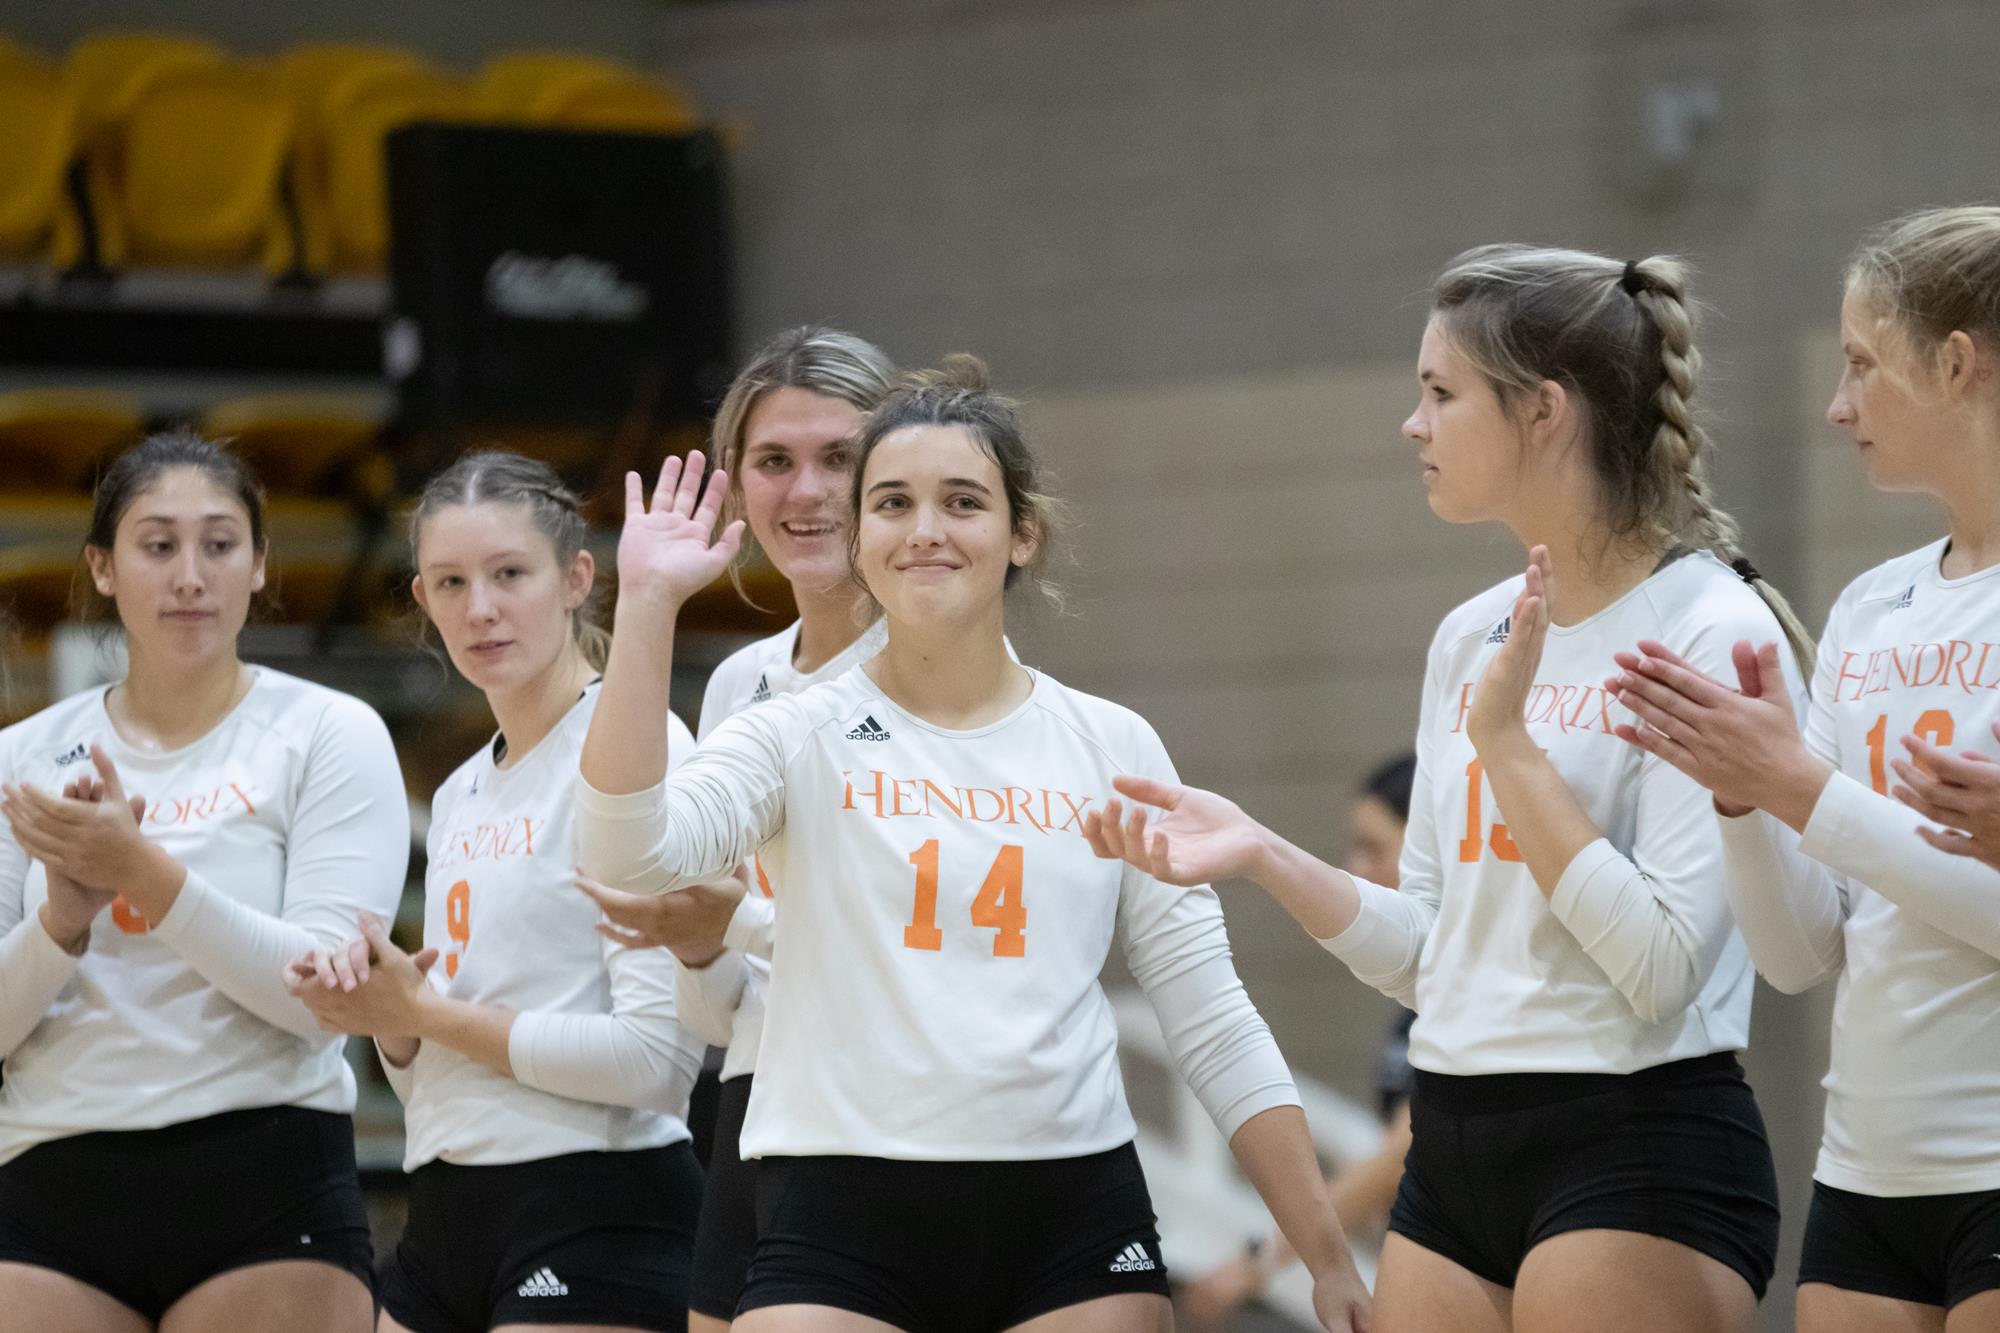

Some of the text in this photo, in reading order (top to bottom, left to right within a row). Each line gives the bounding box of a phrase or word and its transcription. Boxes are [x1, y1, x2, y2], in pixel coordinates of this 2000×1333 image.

[1833, 640, 2000, 702] HENDRI
[1450, 682, 1617, 735] HDRIX
[846, 732, 890, 741] adidas
[144, 783, 260, 826] DRIX
[841, 770, 1094, 838] HENDRIX
[1459, 748, 1548, 863] 1
[438, 816, 545, 868] ENDRIX
[904, 839, 1027, 957] 14
[446, 879, 470, 980] 9
[518, 1284, 568, 1297] adidas
[1110, 1260, 1155, 1272] adidas
